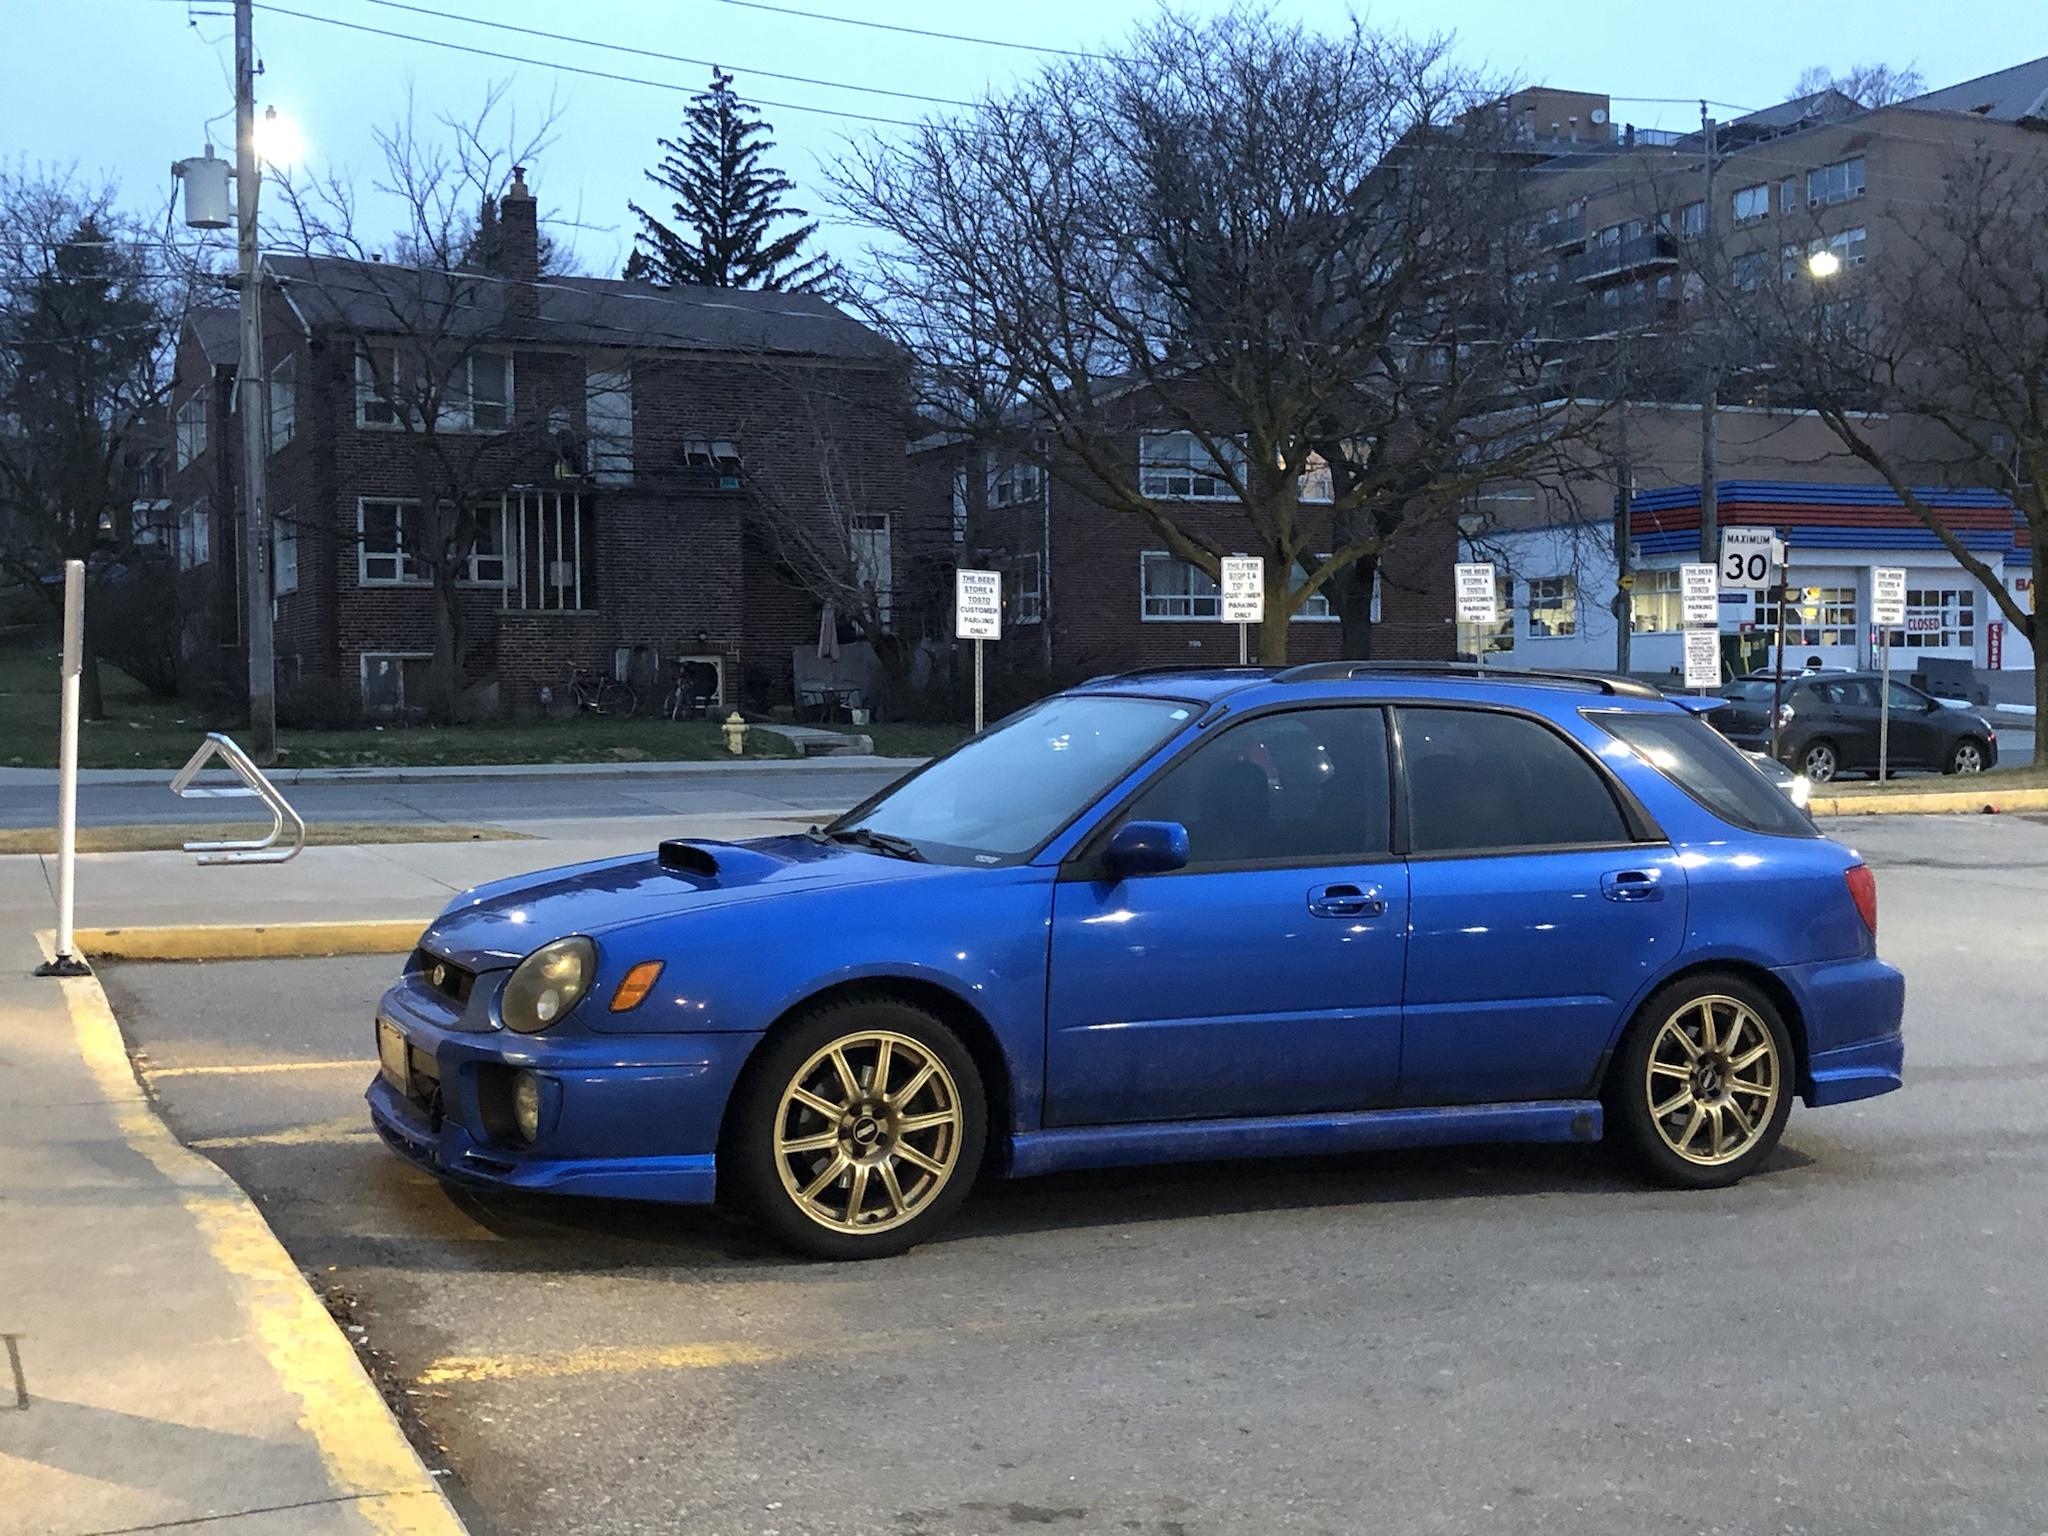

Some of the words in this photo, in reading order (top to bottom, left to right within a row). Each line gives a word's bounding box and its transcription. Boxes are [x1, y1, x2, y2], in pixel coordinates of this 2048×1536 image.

[1727, 535, 1770, 545] MAXIMUM
[1725, 553, 1767, 581] 30
[962, 575, 975, 583] THE
[1687, 577, 1706, 585] STORE
[964, 586, 988, 594] STORE
[960, 606, 998, 614] CUSTOMER
[1908, 618, 1940, 631] CLOSED
[1991, 625, 1999, 669] CLOSED
